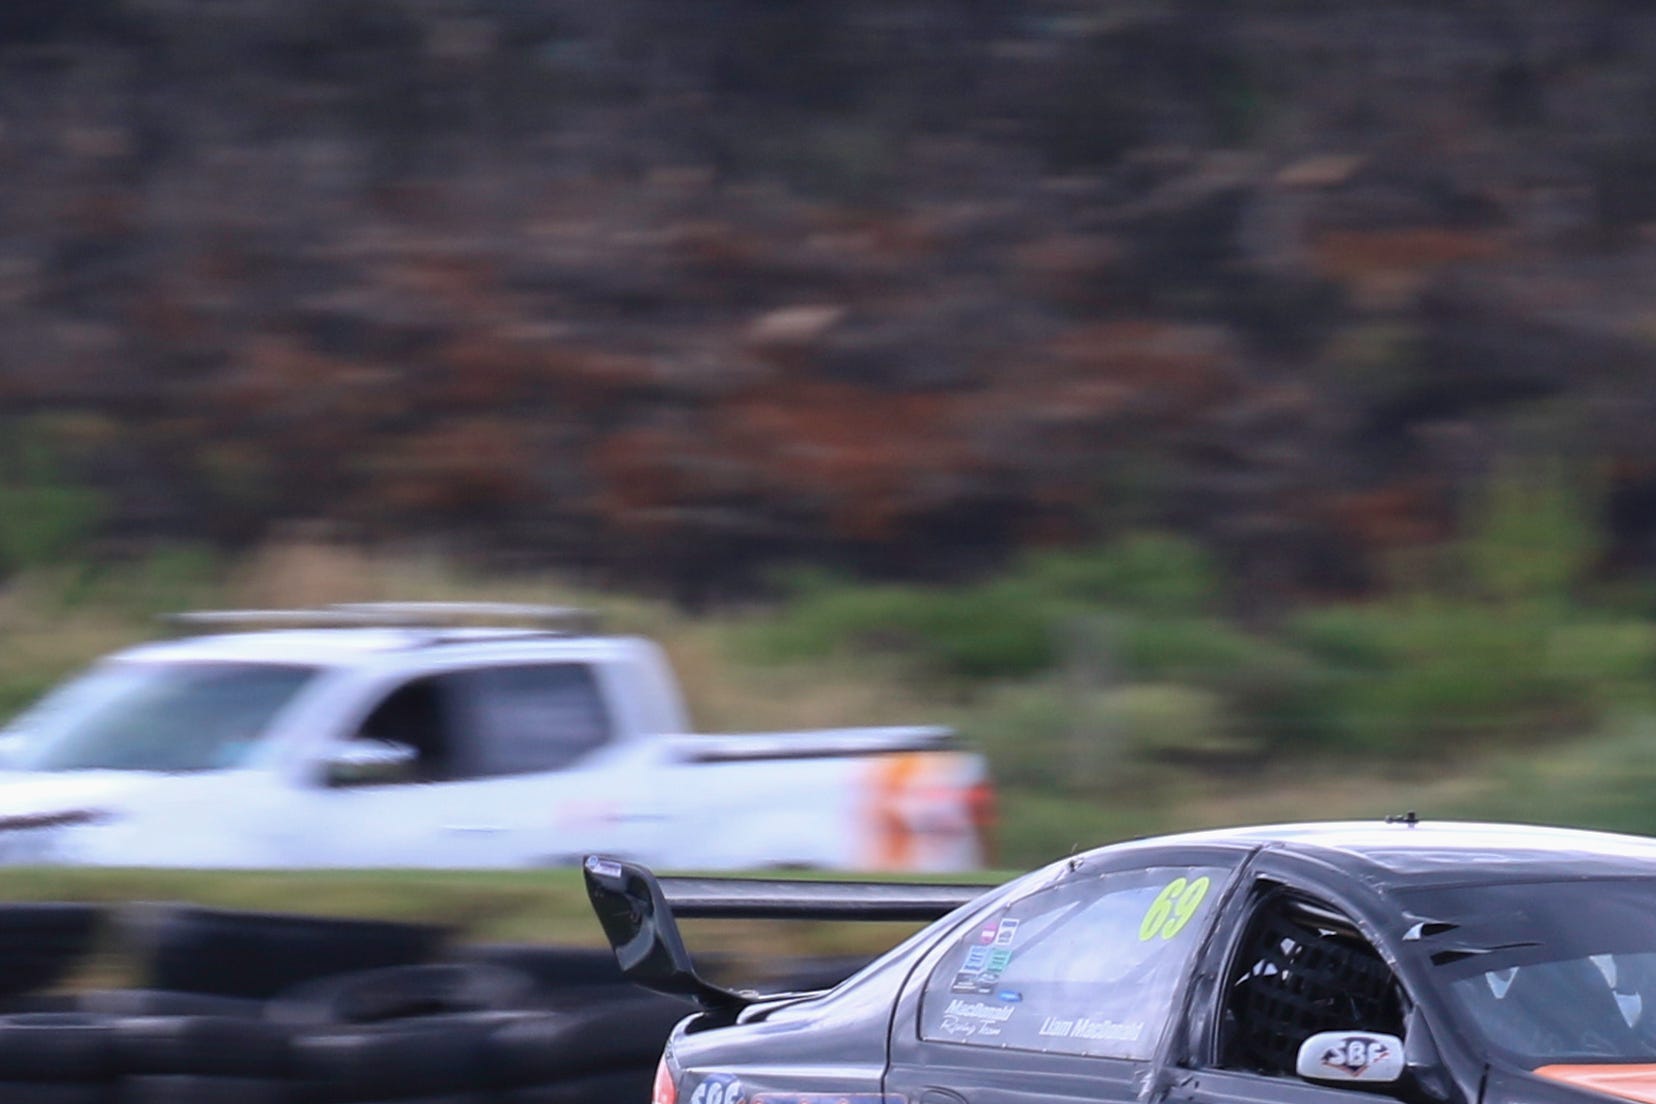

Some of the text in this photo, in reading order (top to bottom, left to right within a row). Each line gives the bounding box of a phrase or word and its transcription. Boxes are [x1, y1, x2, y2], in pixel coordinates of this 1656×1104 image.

[1139, 876, 1210, 941] 69
[1039, 1017, 1073, 1037] Liam
[1326, 1039, 1388, 1068] SBF
